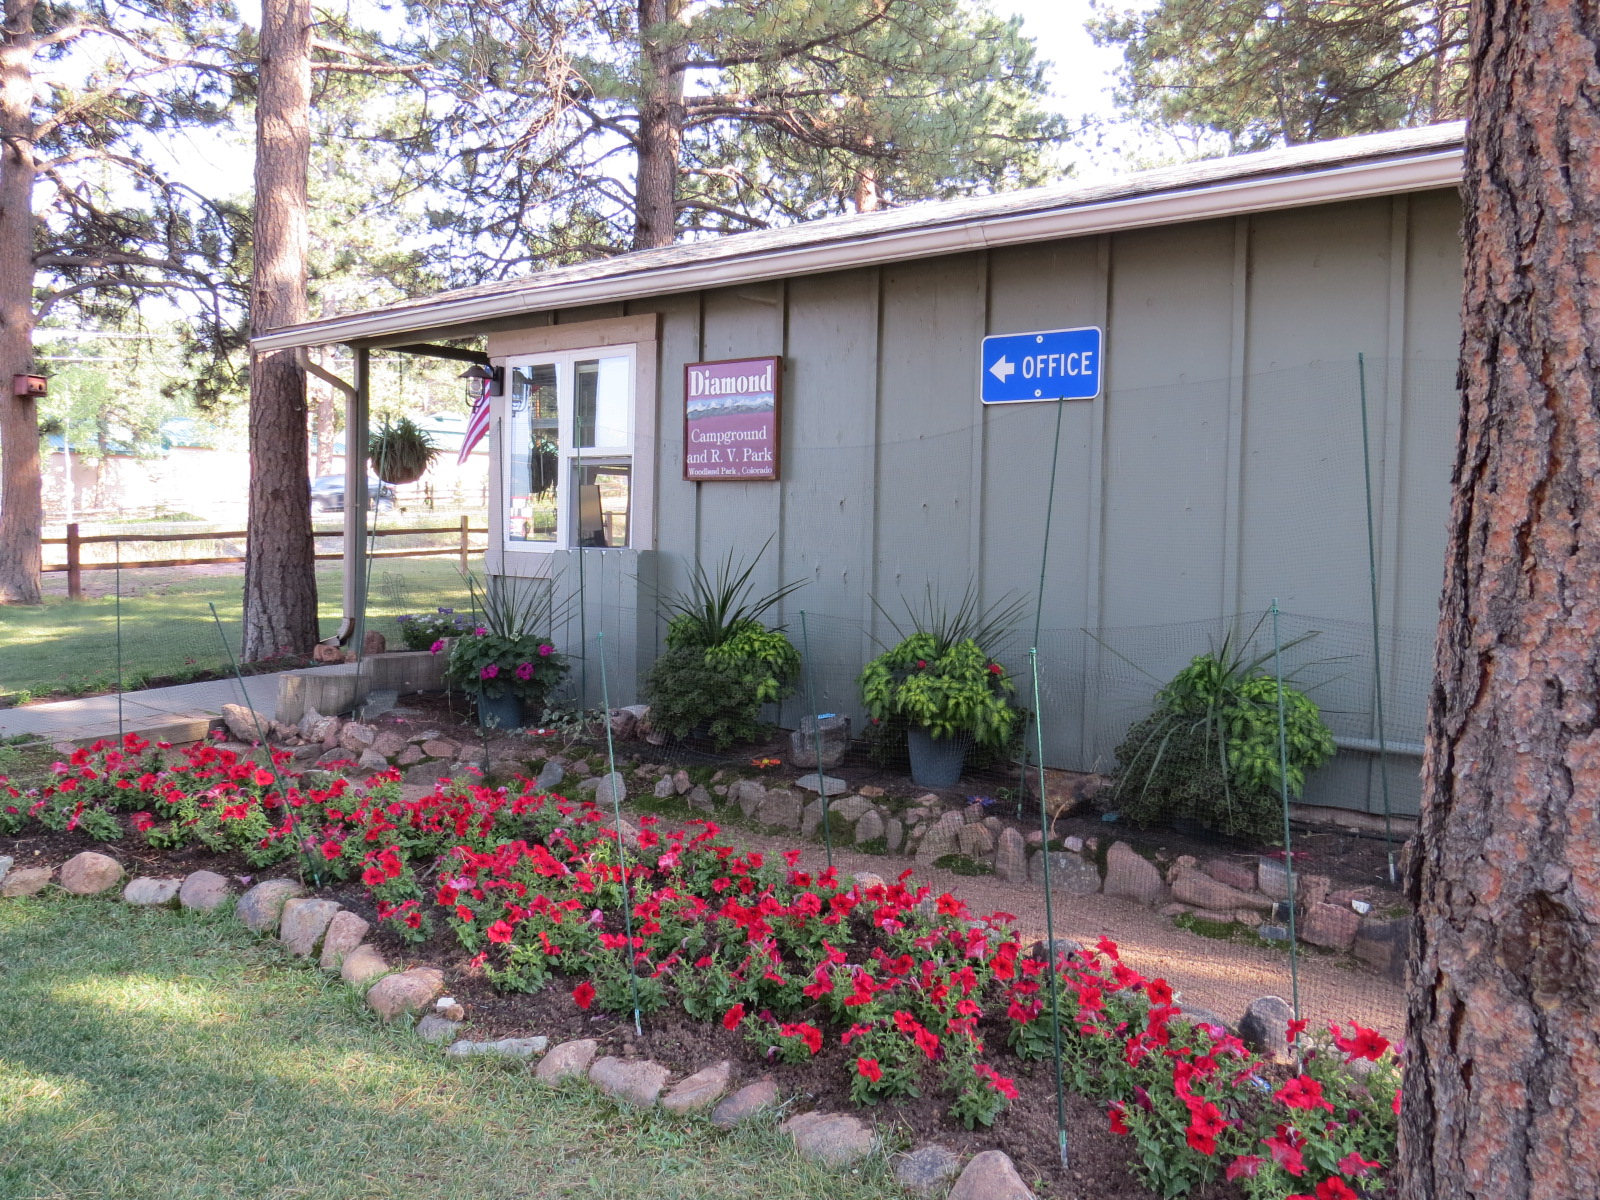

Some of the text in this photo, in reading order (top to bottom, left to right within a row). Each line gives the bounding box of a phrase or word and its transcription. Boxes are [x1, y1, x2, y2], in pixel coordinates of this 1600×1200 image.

[1022, 351, 1093, 379] OFFICE
[690, 365, 772, 396] Diamond
[691, 425, 767, 445] Campground
[687, 449, 707, 464] and
[743, 447, 773, 462] Park
[688, 467, 720, 476] Woodland
[742, 465, 773, 475] Colorado
